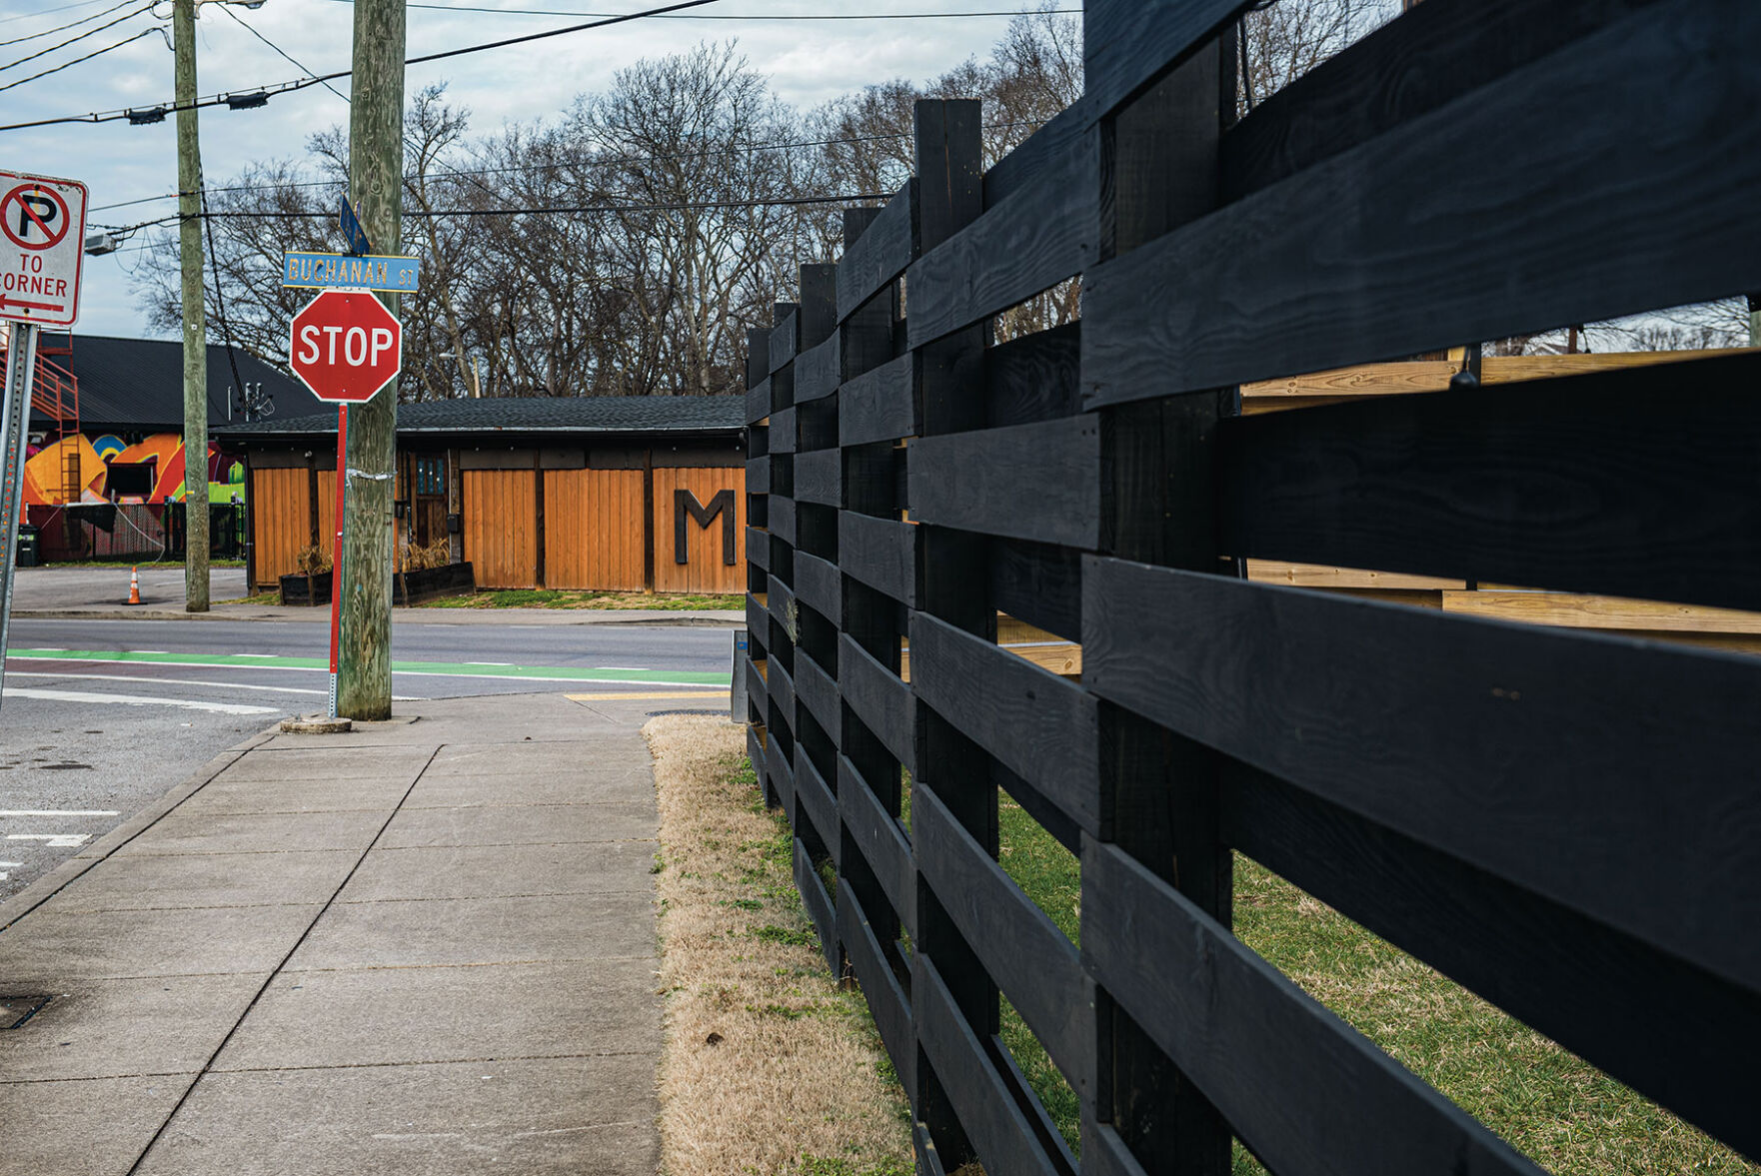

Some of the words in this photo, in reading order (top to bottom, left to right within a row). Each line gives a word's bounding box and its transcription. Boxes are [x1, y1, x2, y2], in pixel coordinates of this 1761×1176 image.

[20, 253, 43, 274] TO
[288, 257, 388, 285] BUCHANAN
[398, 268, 414, 286] ST
[0, 272, 67, 298] ORNER
[298, 324, 394, 367] STOP
[674, 489, 737, 567] M
